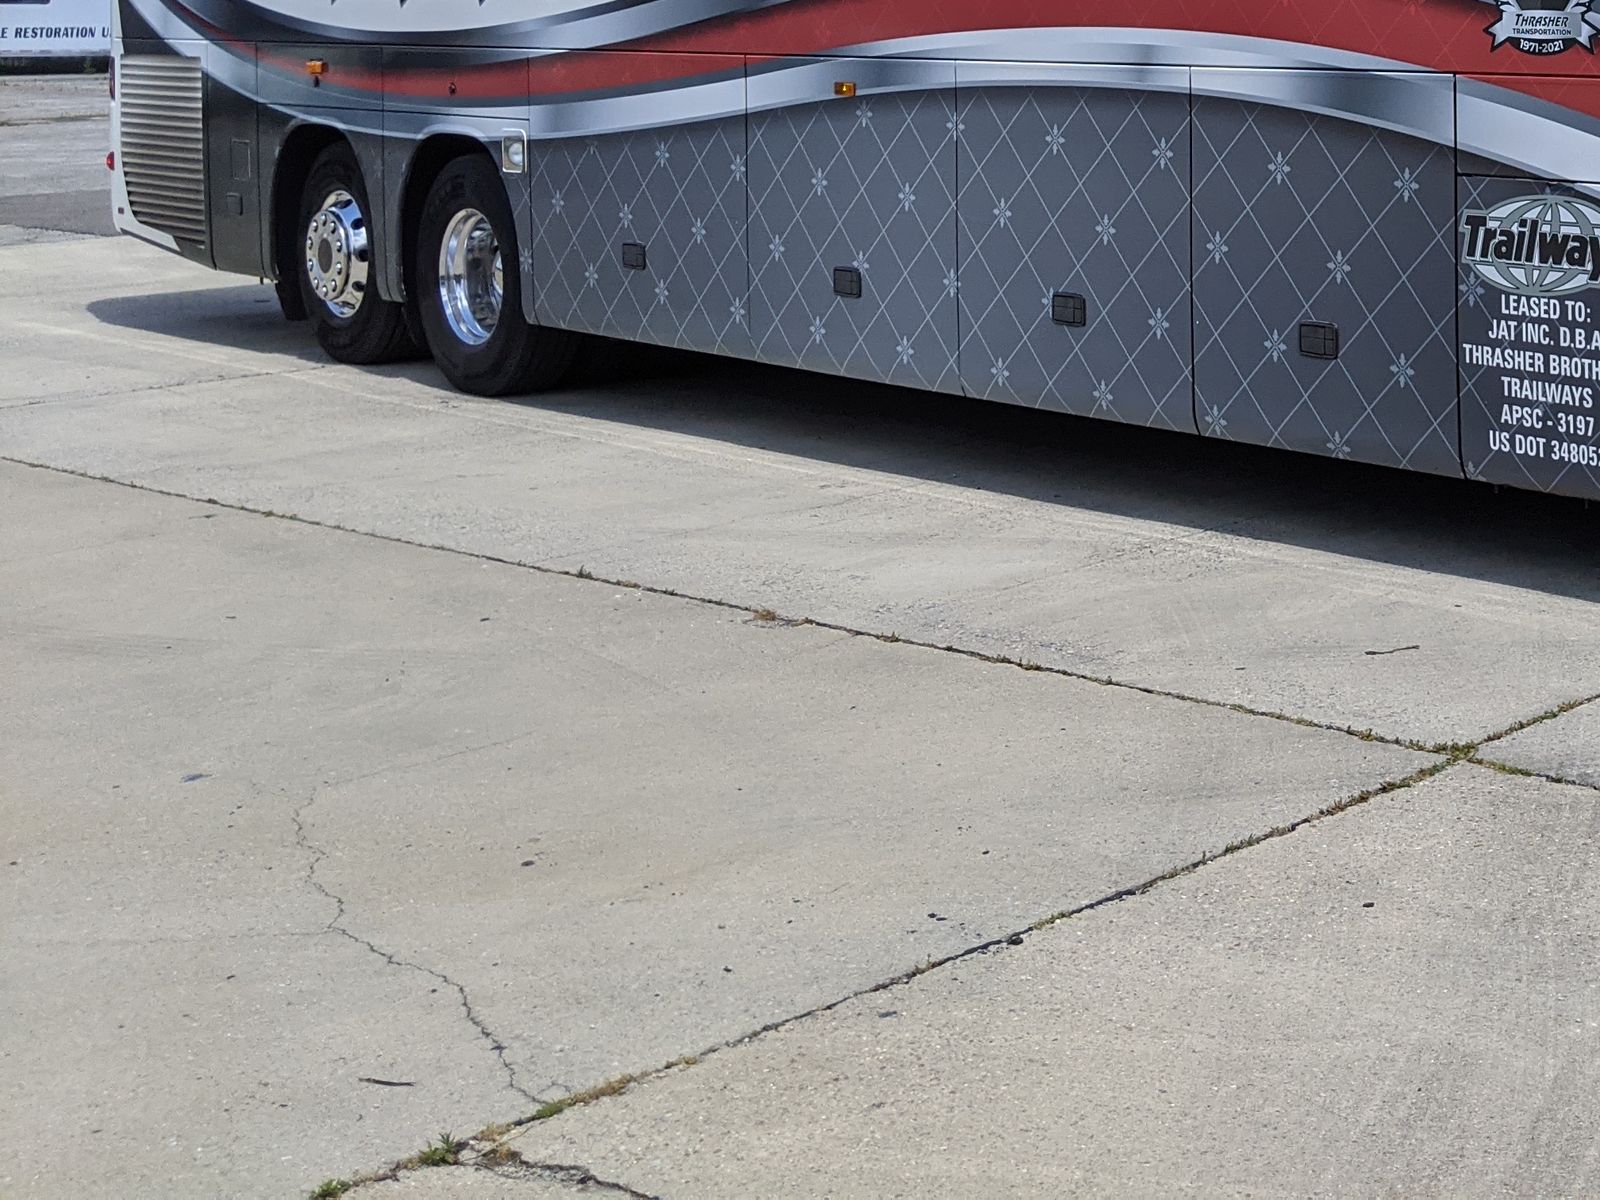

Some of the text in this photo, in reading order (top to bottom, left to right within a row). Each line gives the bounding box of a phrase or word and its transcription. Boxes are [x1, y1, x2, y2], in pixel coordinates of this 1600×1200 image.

[15, 27, 96, 39] RESTORATION
[102, 27, 111, 38] U
[1512, 28, 1572, 36] TRANSPORTATION
[1514, 13, 1569, 28] THRASHER
[1519, 38, 1564, 53] 1971-2021
[1501, 294, 1591, 323] LEASED TO:
[1488, 319, 1517, 340] JAT
[1522, 323, 1554, 345] INC.
[1463, 344, 1544, 374] THRASHER
[1501, 376, 1593, 408] TRAILWAYS
[1500, 404, 1543, 429] APSC
[1557, 414, 1594, 437] 3197
[1489, 430, 1510, 452] US
[1515, 434, 1546, 458] DOT
